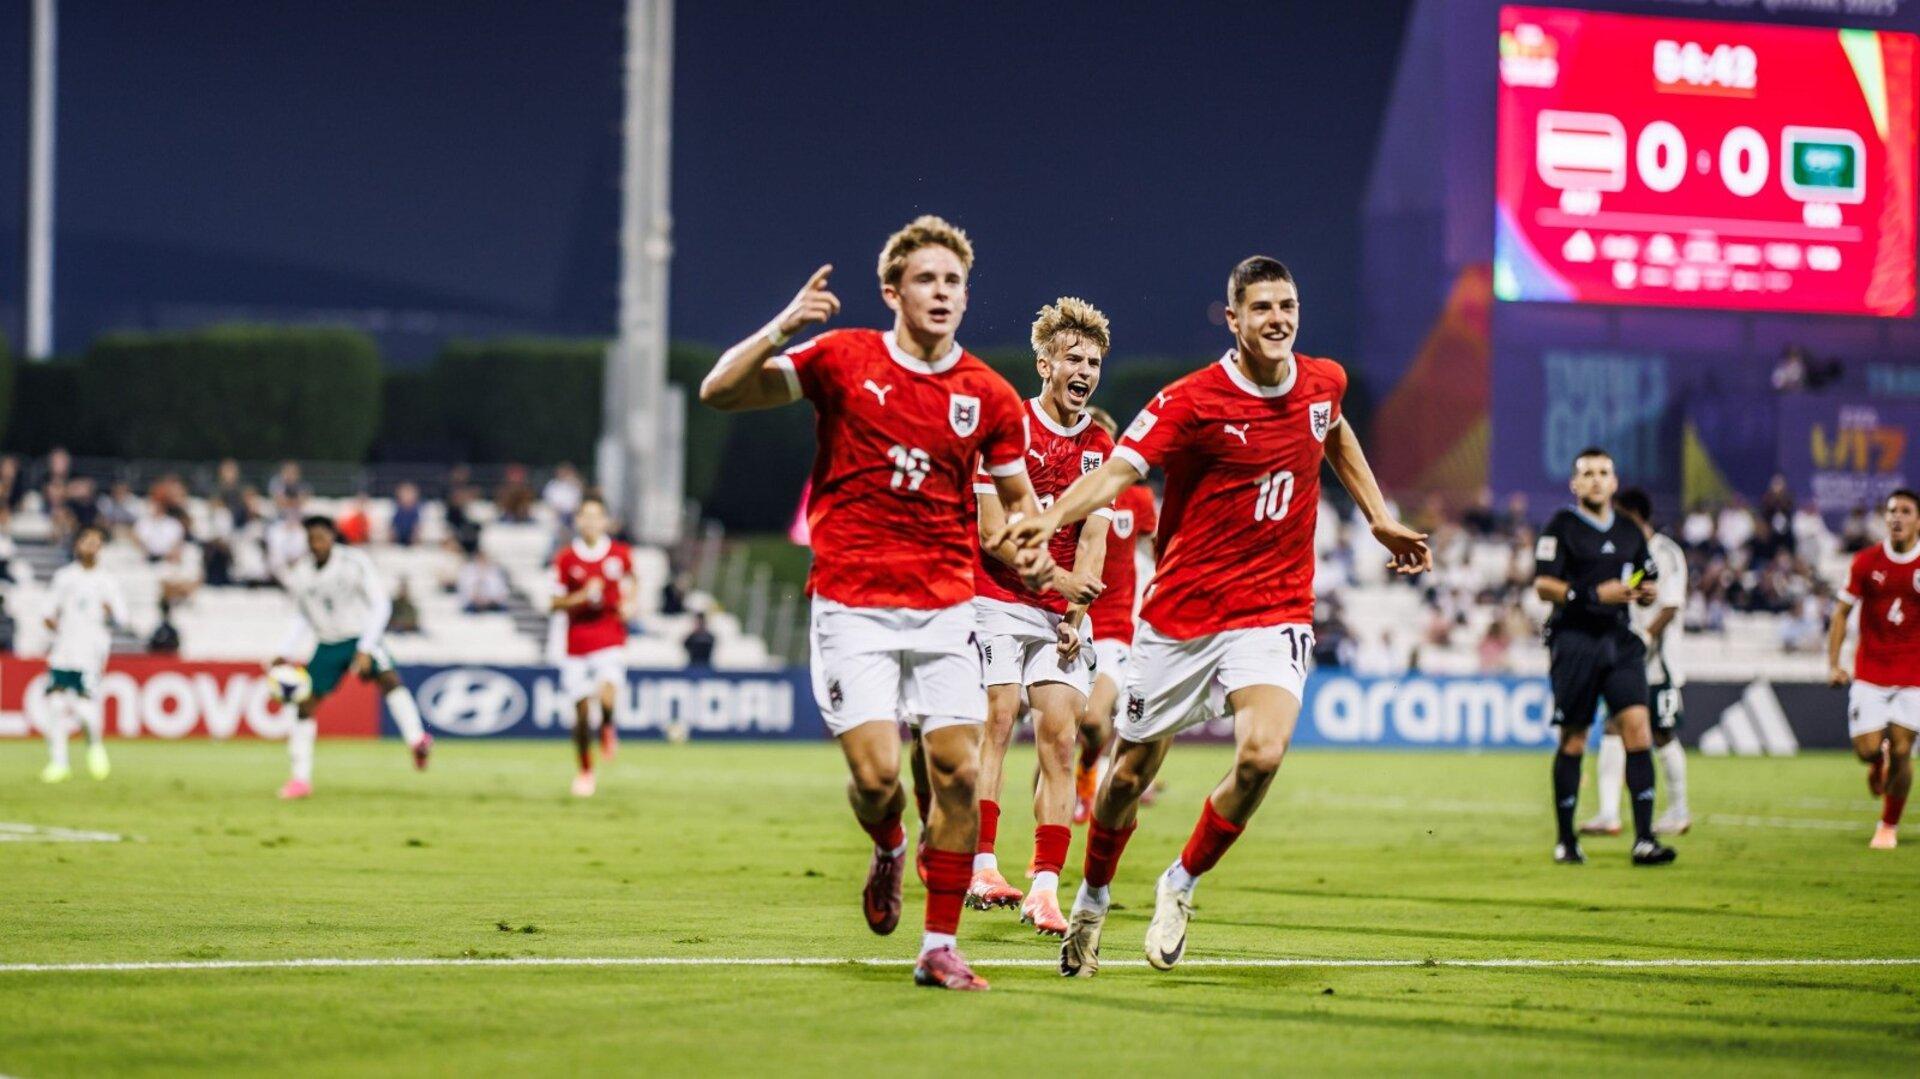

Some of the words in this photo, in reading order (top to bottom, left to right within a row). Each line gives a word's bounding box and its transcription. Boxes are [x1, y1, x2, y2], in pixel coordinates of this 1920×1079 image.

[1636, 120, 1688, 193] 0
[1719, 125, 1770, 198] 0
[887, 444, 931, 491] 19
[1253, 470, 1295, 521] 10
[1887, 597, 1905, 626] 4
[533, 676, 794, 732] HUNDAI
